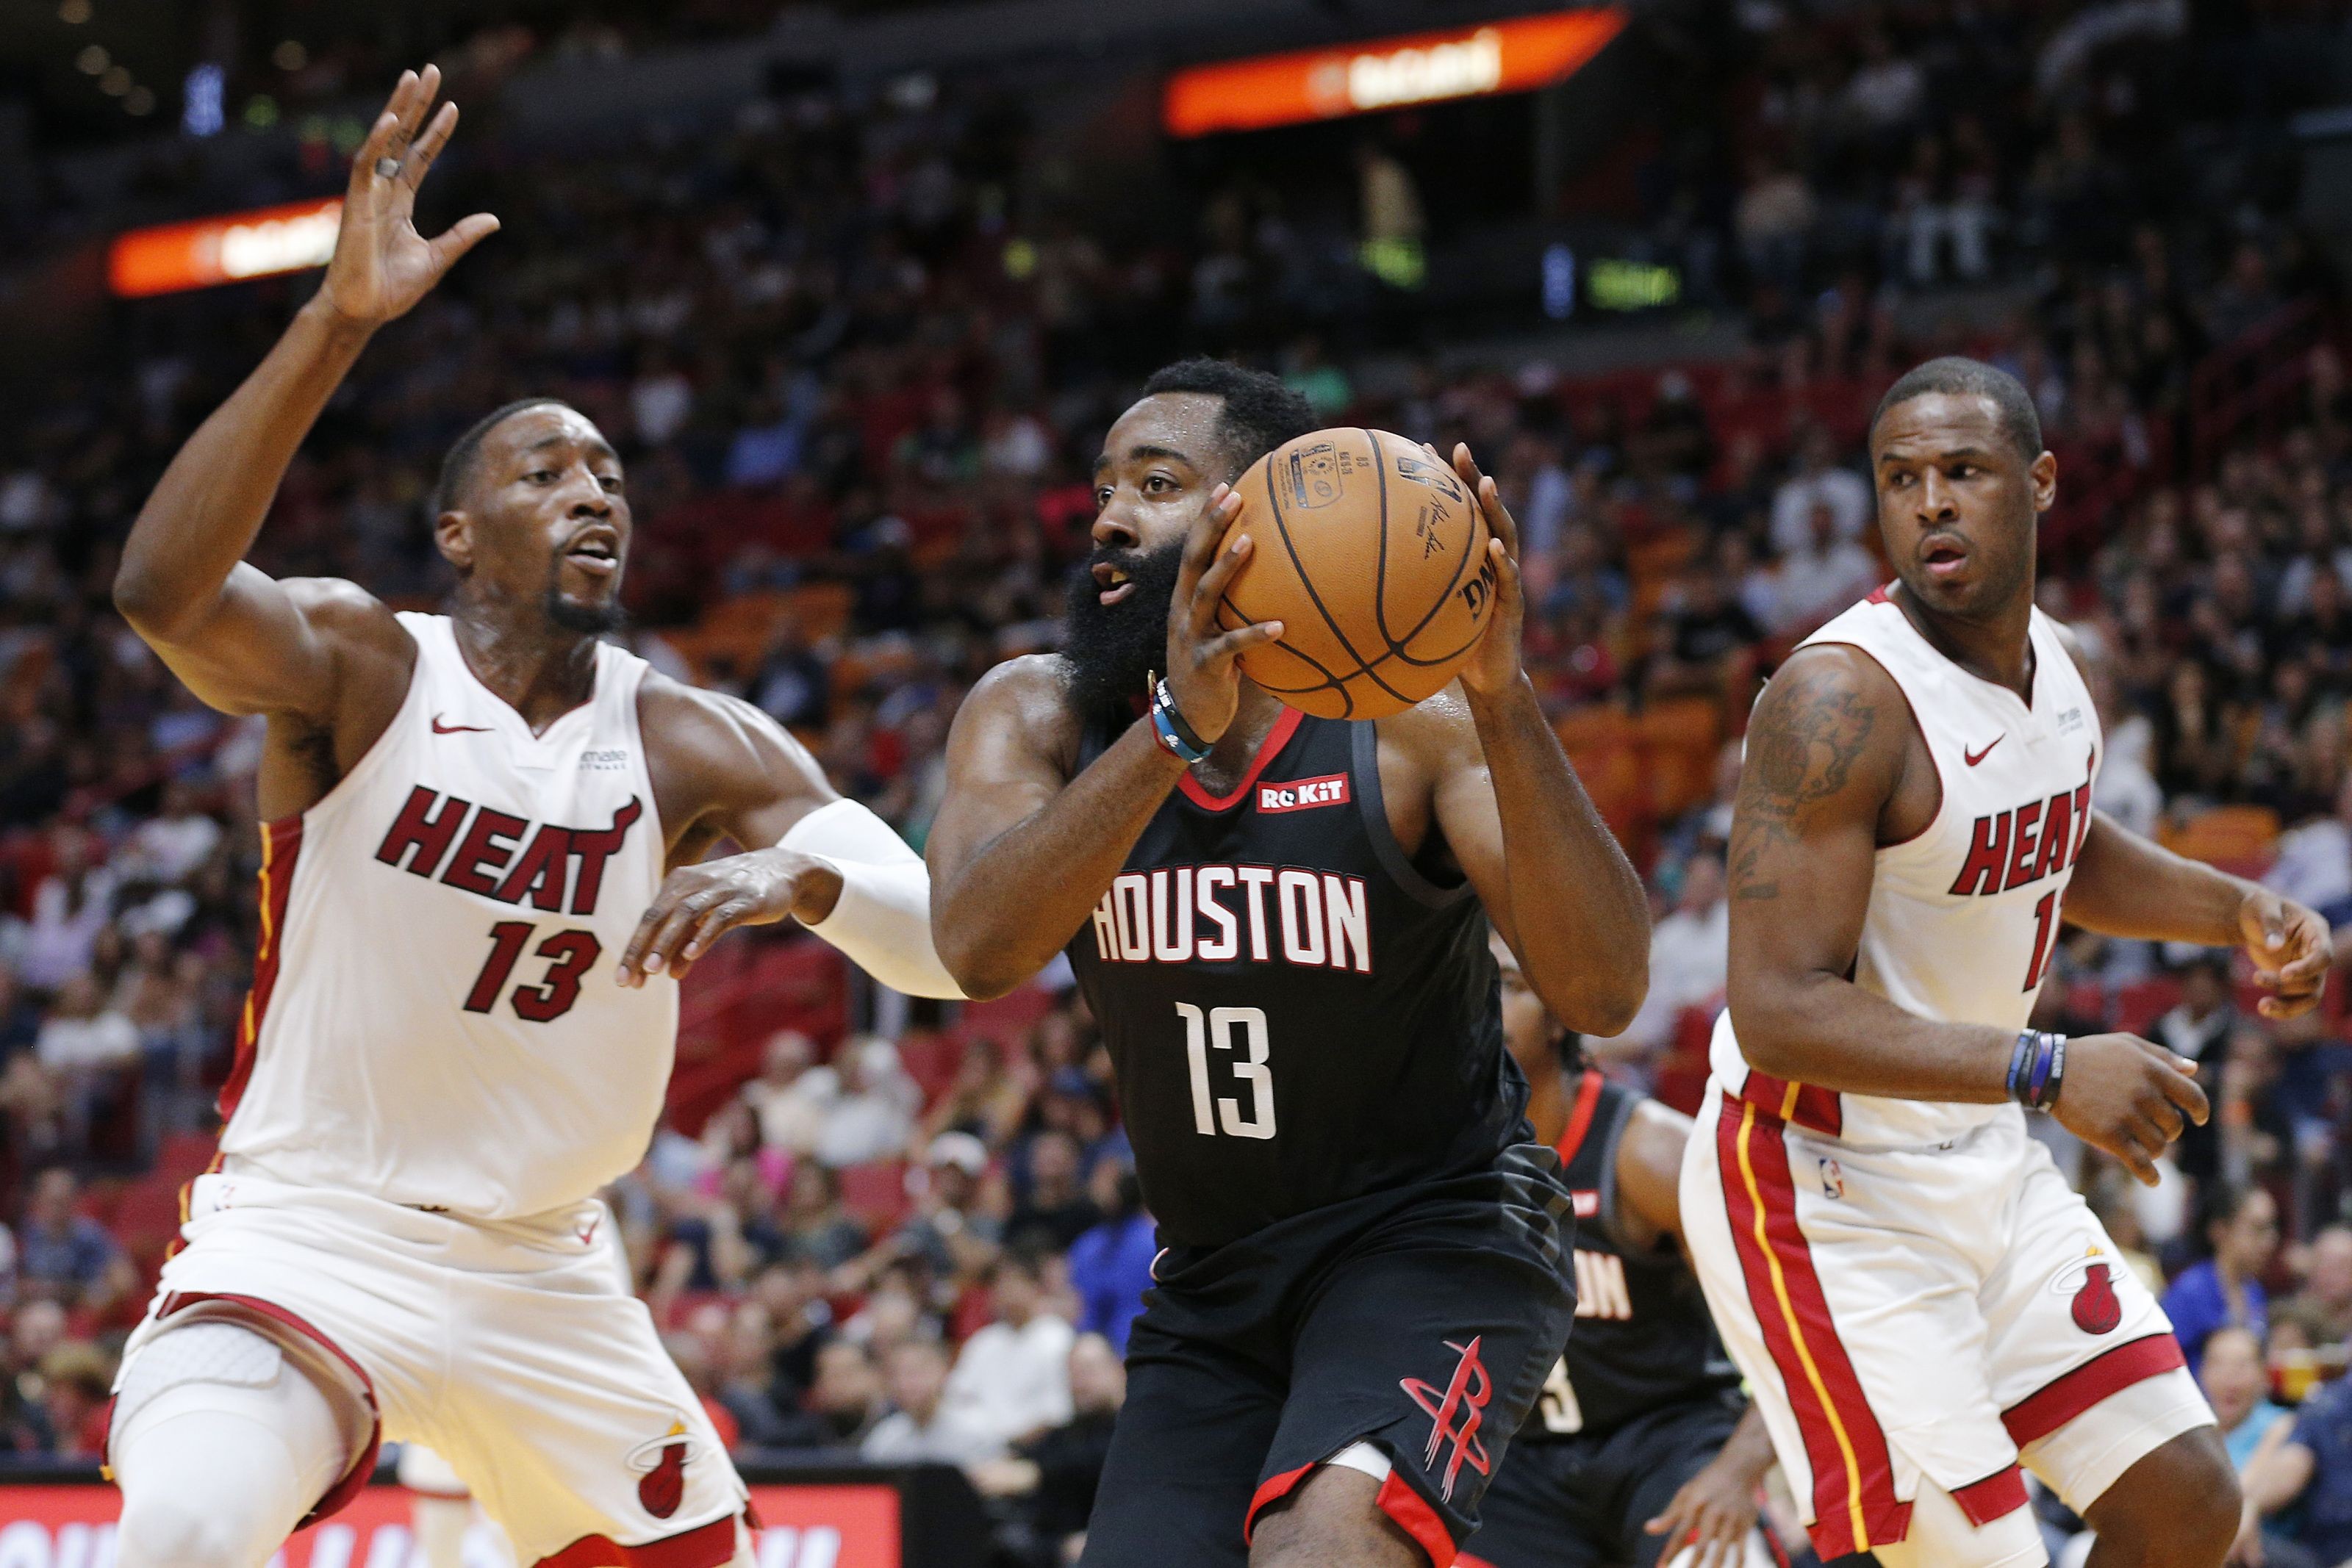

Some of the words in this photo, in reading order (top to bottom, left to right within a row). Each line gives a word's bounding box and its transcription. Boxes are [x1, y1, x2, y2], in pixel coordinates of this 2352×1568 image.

[375, 784, 642, 916] HEAT
[1948, 743, 2095, 896] HEAT
[463, 921, 602, 1023] 13
[1092, 863, 1372, 974] HOUSTON
[1175, 1001, 1277, 1140] 13
